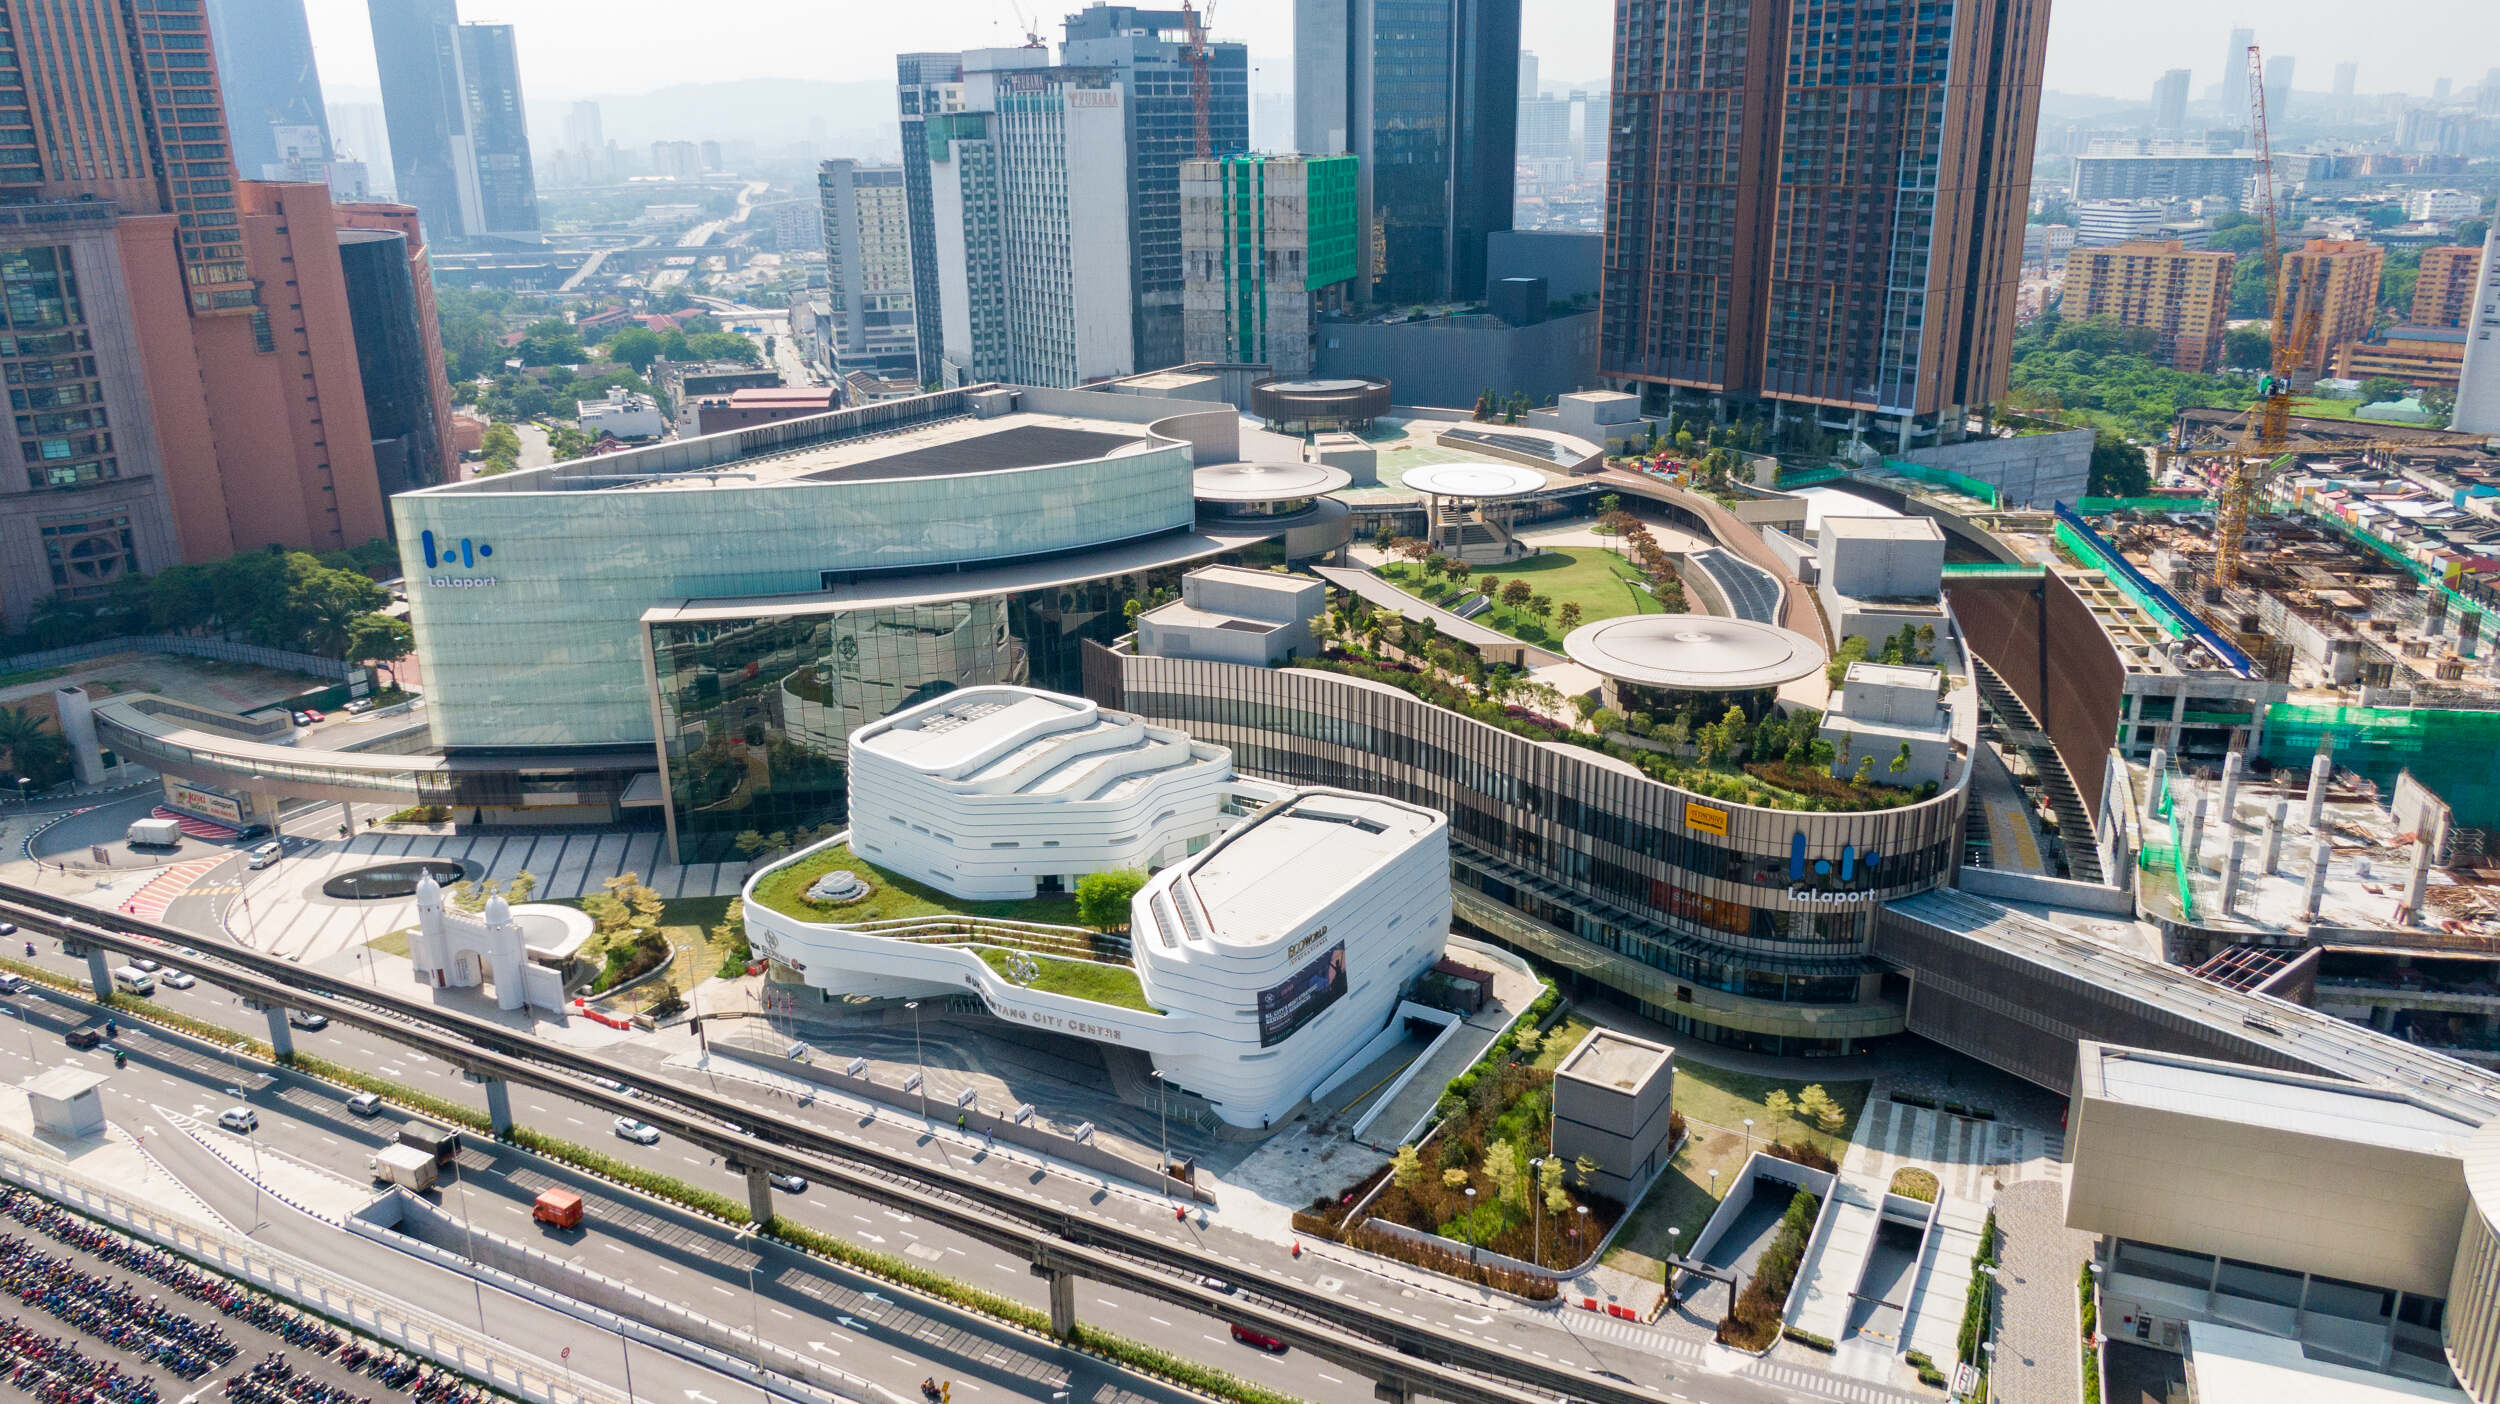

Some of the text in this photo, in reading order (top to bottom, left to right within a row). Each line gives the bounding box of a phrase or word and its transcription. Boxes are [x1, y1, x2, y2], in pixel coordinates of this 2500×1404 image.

[1078, 92, 1118, 105] FURAMA
[428, 575, 496, 590] LaLaport
[1788, 886, 1876, 906] LaLaport
[1287, 925, 1328, 960] ECOWORLD
[1032, 1011, 1063, 1027] CITY
[1068, 1018, 1121, 1040] CENTRE
